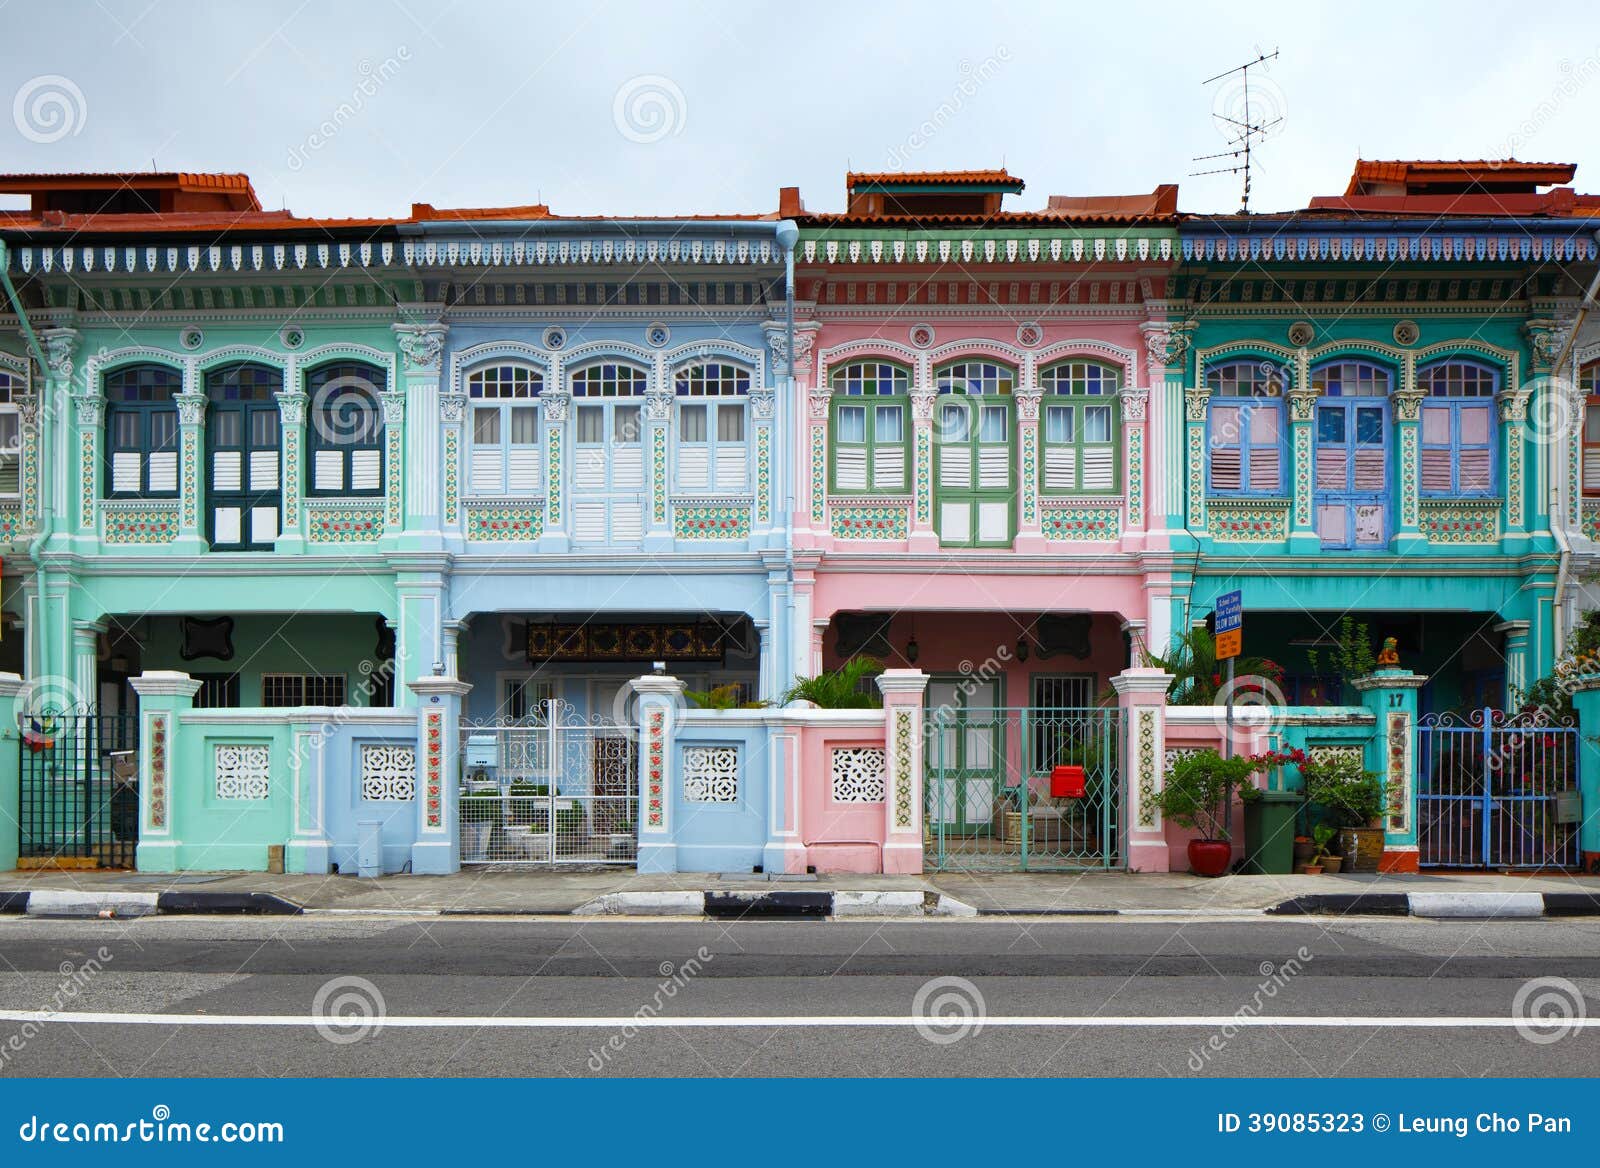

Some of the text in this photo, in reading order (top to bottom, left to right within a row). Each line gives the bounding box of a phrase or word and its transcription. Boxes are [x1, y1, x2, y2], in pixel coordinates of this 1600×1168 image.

[1216, 614, 1241, 630] SLOW DOWN
[1389, 693, 1404, 707] 17
